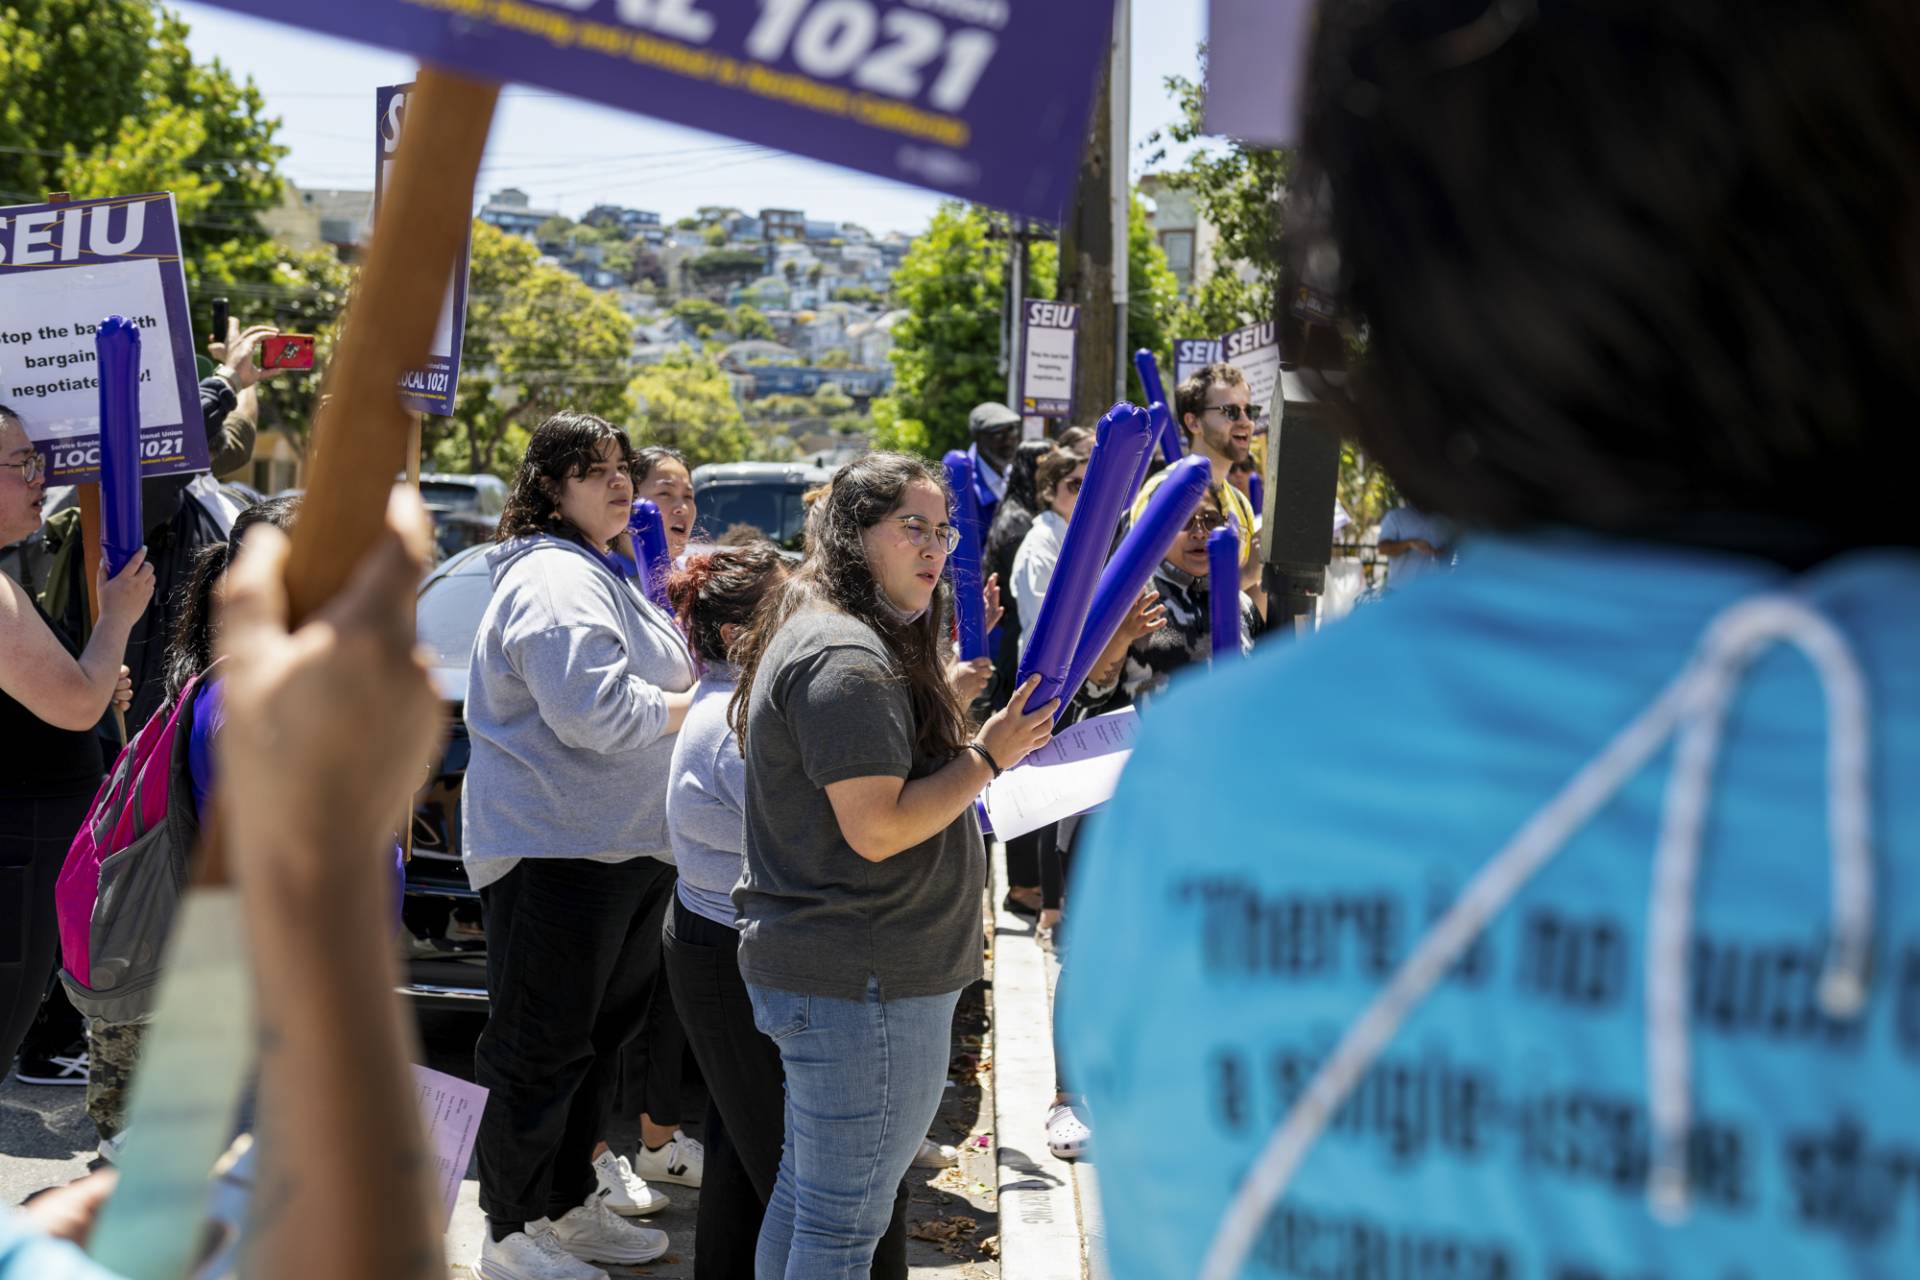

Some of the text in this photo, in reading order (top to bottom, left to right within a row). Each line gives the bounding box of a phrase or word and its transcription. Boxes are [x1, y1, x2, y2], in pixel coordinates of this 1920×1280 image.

[745, 0, 997, 112] 1021
[1029, 303, 1075, 328] SEIU
[0, 315, 156, 345] top the ba ith
[1227, 320, 1275, 357] SEIU
[25, 350, 96, 368] bargain
[12, 376, 99, 398] negotiate
[400, 370, 449, 392] OCAL 1021
[54, 437, 183, 469] LOC 1021
